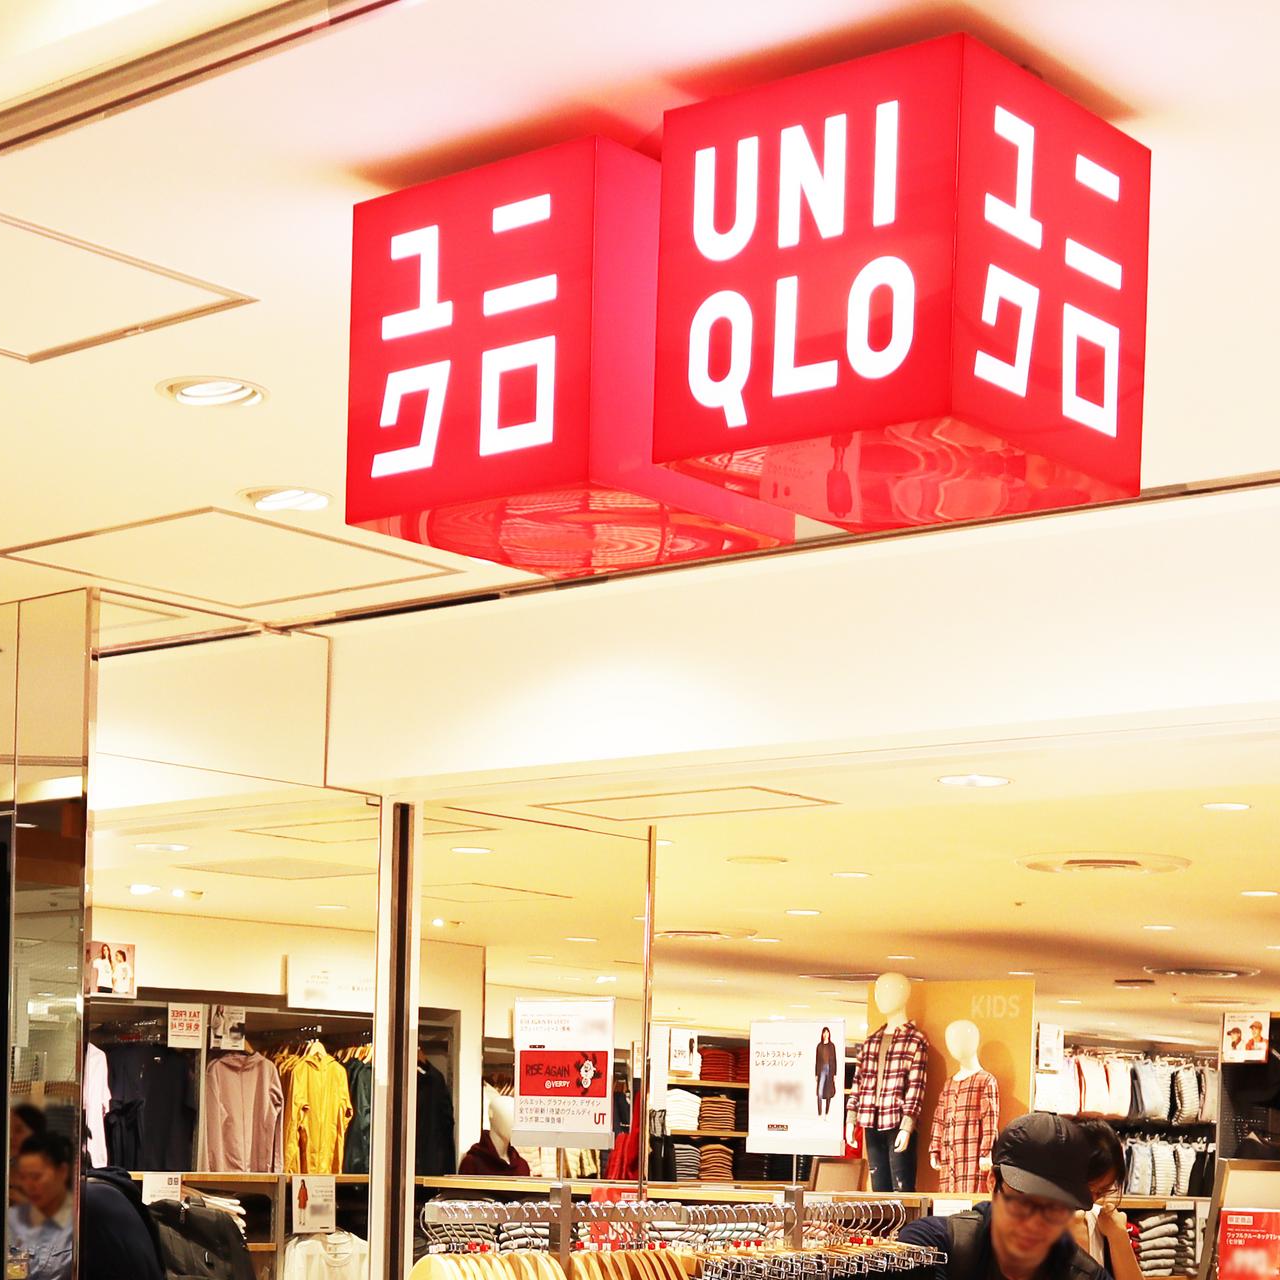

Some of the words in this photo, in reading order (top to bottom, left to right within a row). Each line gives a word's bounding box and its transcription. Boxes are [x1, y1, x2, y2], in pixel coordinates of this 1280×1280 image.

[692, 99, 899, 262] UNI
[984, 105, 1121, 290] ユニ
[382, 193, 557, 341] ユニ
[371, 334, 555, 479] クロ
[687, 254, 916, 429] QLO
[974, 262, 1120, 437] クロ
[526, 1064, 543, 1076] RISE
[545, 1065, 570, 1078] AGAIN
[971, 993, 1021, 1018] KIDS
[594, 1113, 606, 1125] UT
